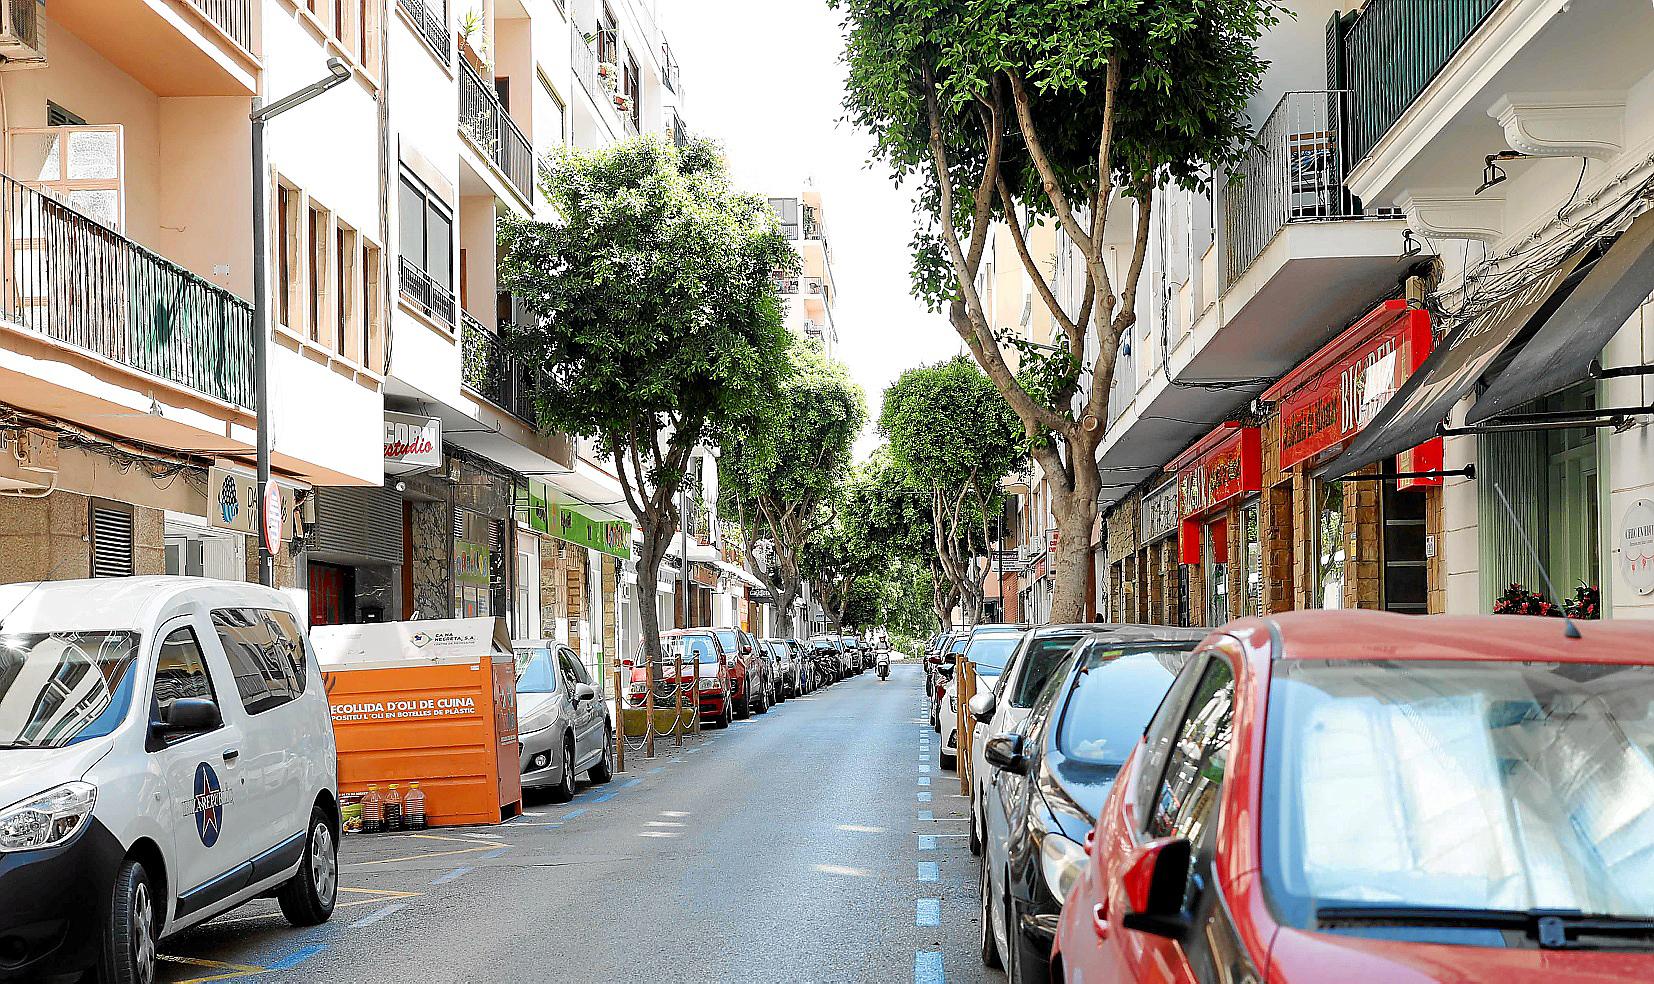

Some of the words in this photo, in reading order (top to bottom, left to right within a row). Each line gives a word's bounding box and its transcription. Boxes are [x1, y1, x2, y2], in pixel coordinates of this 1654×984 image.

[331, 702, 384, 714] ECOLLIDA
[420, 699, 434, 709] DE
[437, 697, 474, 708] CUINA
[397, 710, 431, 718] BOTELLES
[445, 706, 475, 714] PLÀSTIC
